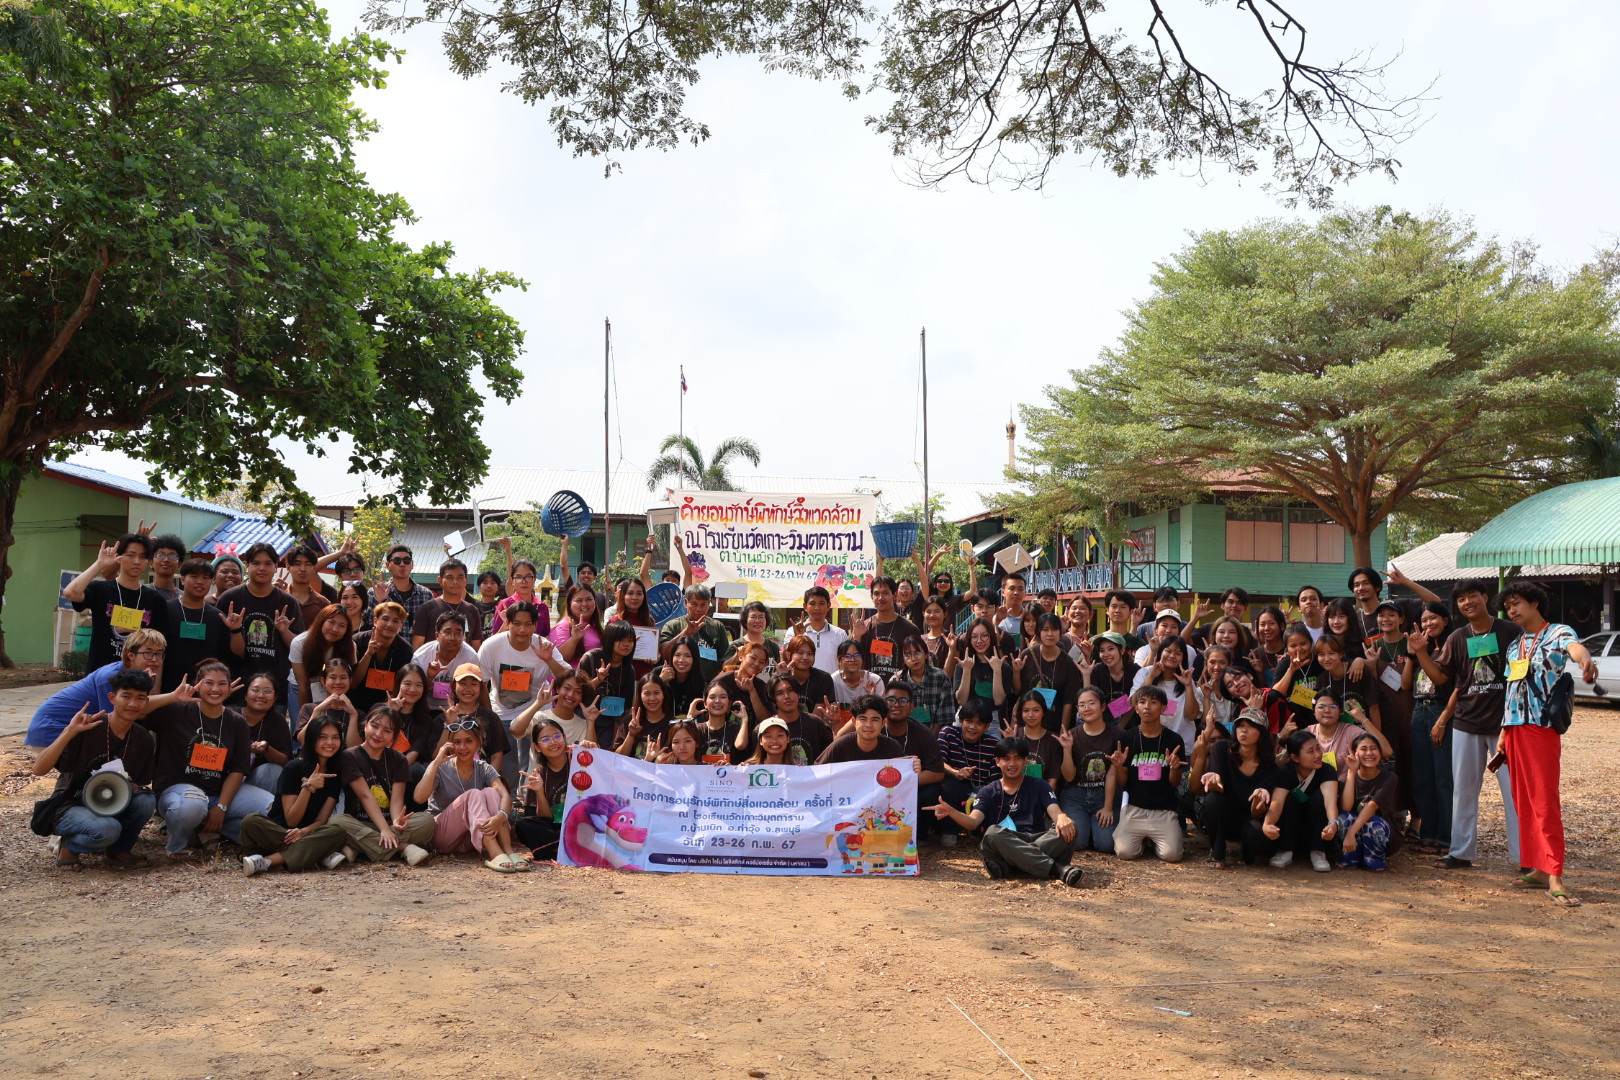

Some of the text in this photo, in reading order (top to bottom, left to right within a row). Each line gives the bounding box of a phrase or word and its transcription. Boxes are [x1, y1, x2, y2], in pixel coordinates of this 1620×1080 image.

[806, 572, 818, 580] 67
[748, 773, 779, 787] ICL
[804, 793, 832, 807] ครั้งที่
[838, 797, 851, 806] 21
[678, 811, 689, 819] ณ
[711, 838, 746, 848] 23-26
[751, 840, 775, 849] ก.พ.
[781, 841, 796, 849] 67
